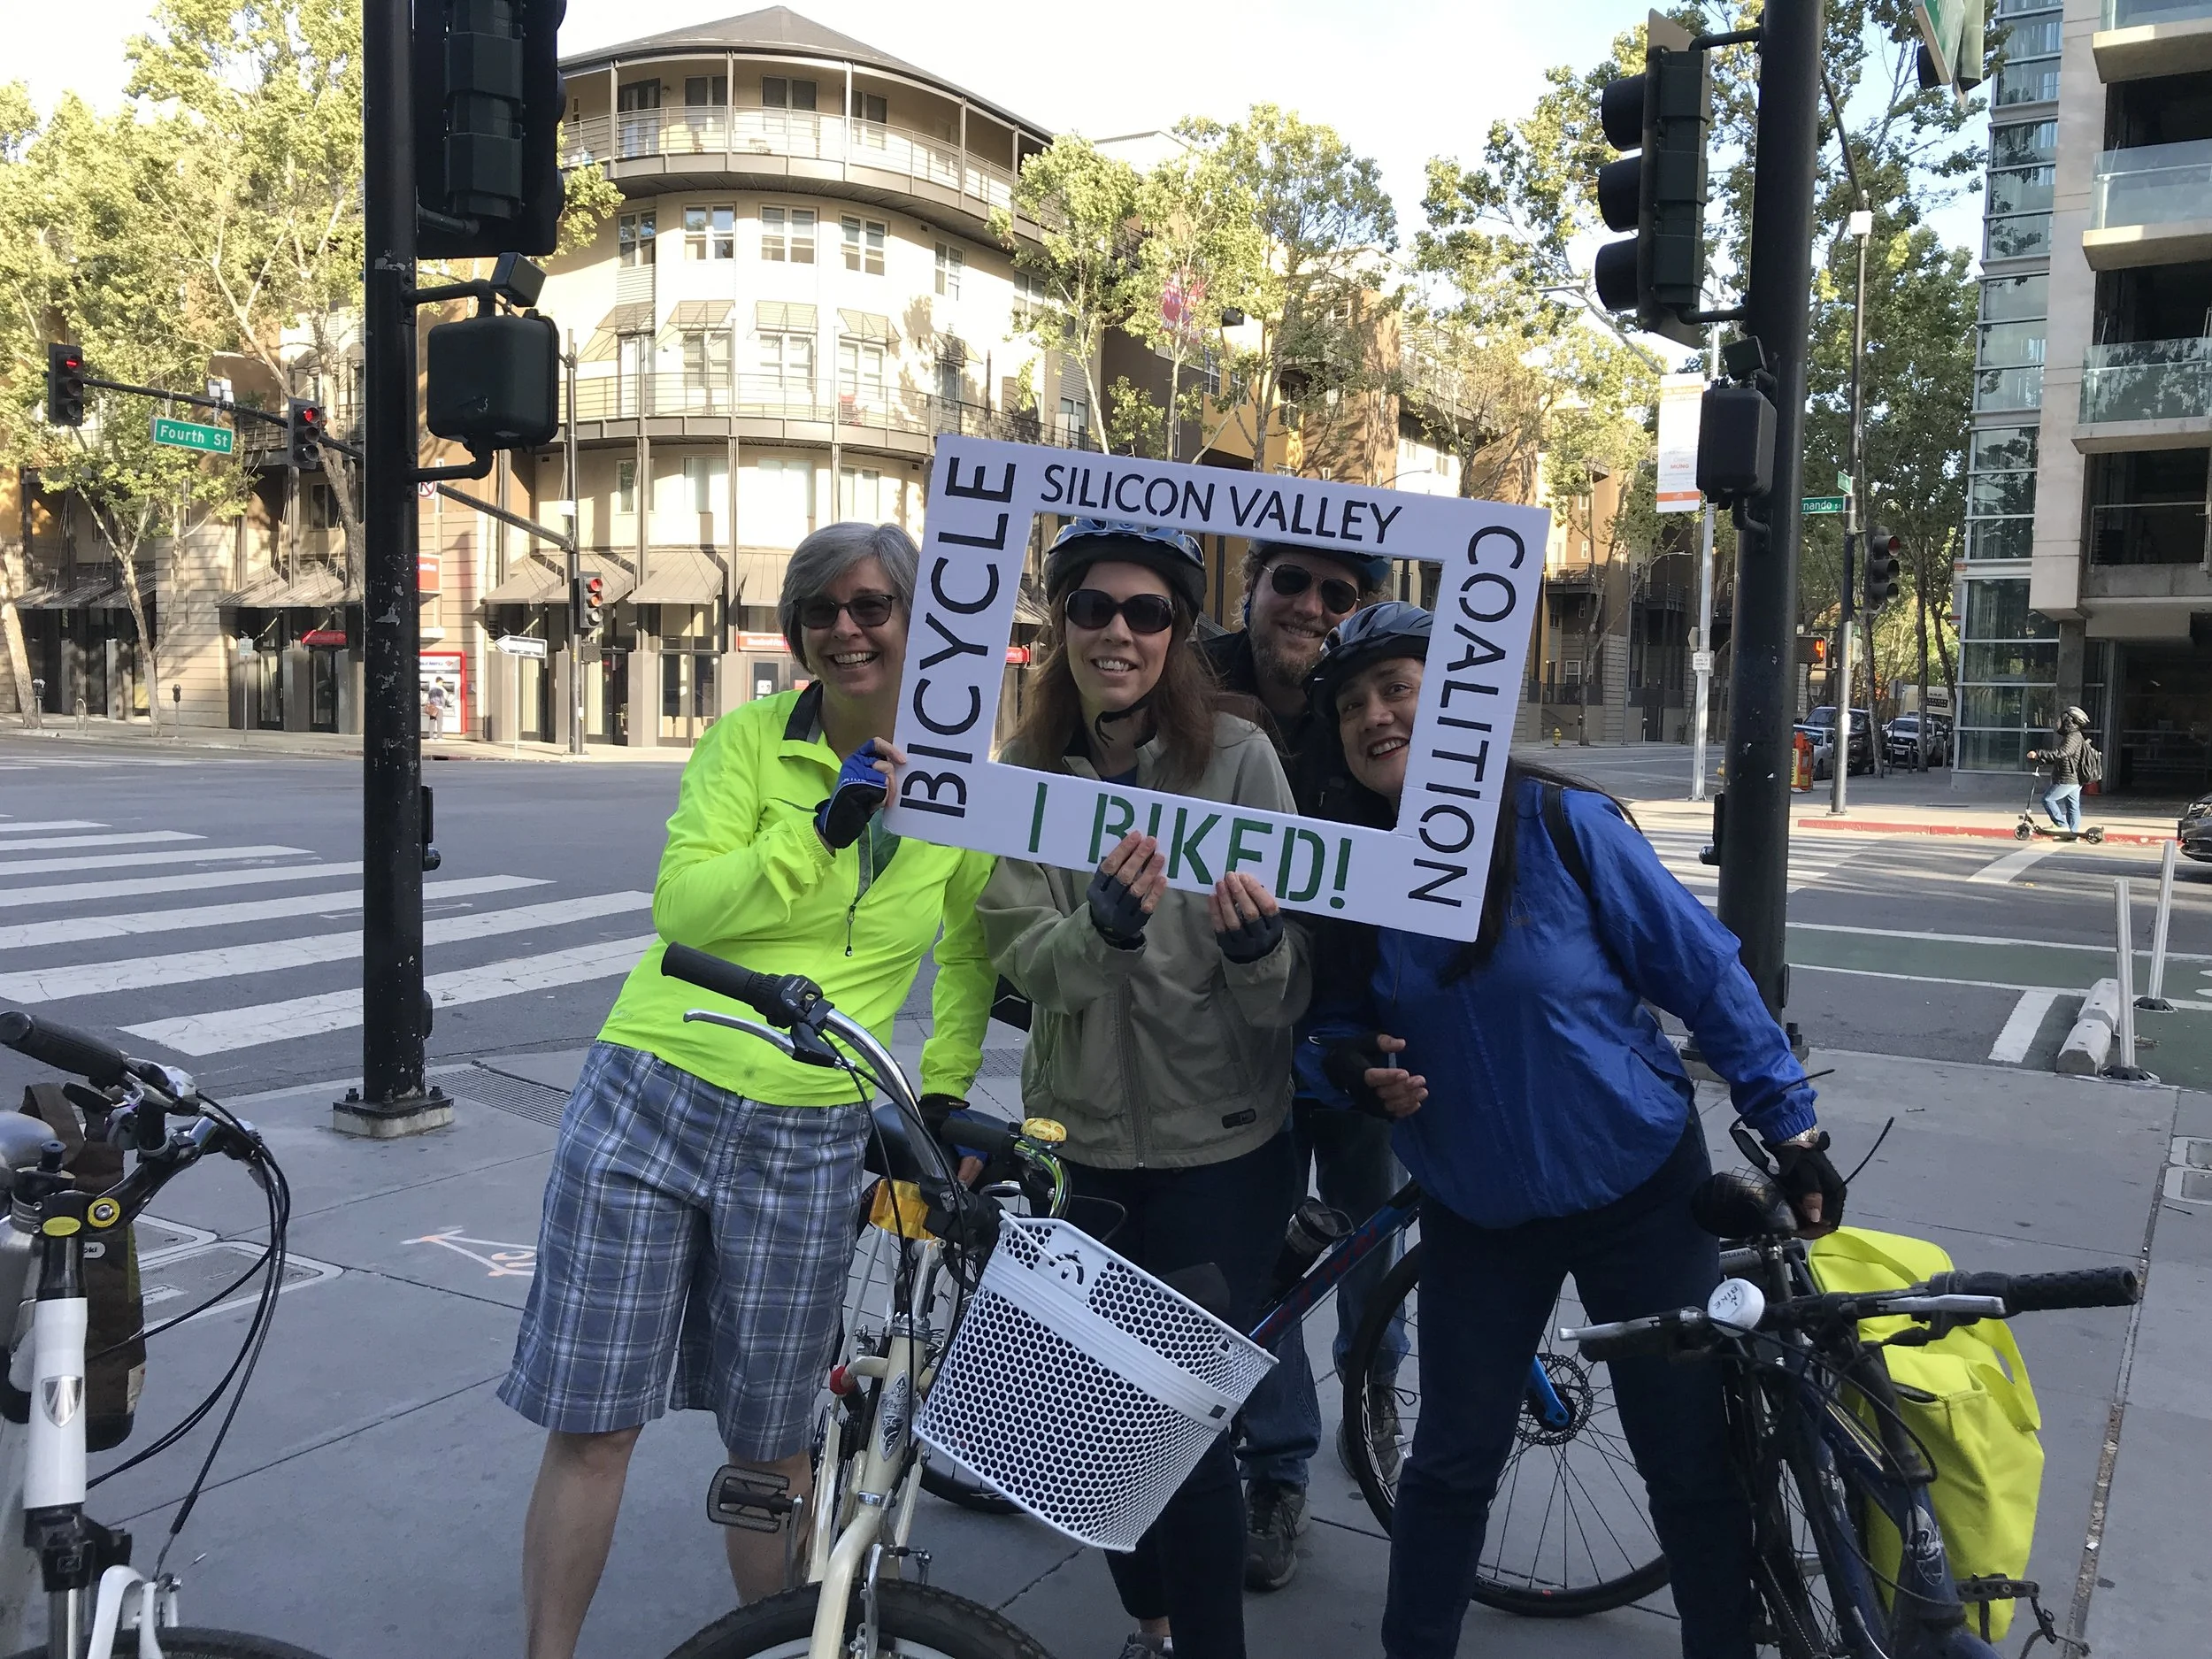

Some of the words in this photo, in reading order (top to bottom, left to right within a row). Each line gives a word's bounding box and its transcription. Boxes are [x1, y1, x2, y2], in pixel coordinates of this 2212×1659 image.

[160, 425, 205, 444] Fourth
[213, 434, 228, 447] St
[1041, 464, 1215, 522] SILICON
[1229, 486, 1402, 544] VALLEY
[1801, 500, 1832, 511] nando
[900, 457, 1017, 818] BICYCLE
[1816, 641, 1824, 658] 4
[1408, 526, 1525, 907] COALITION
[1028, 781, 1048, 854] I
[1088, 793, 1352, 910] BIKED!
[1713, 1286, 1739, 1310] BIKE
